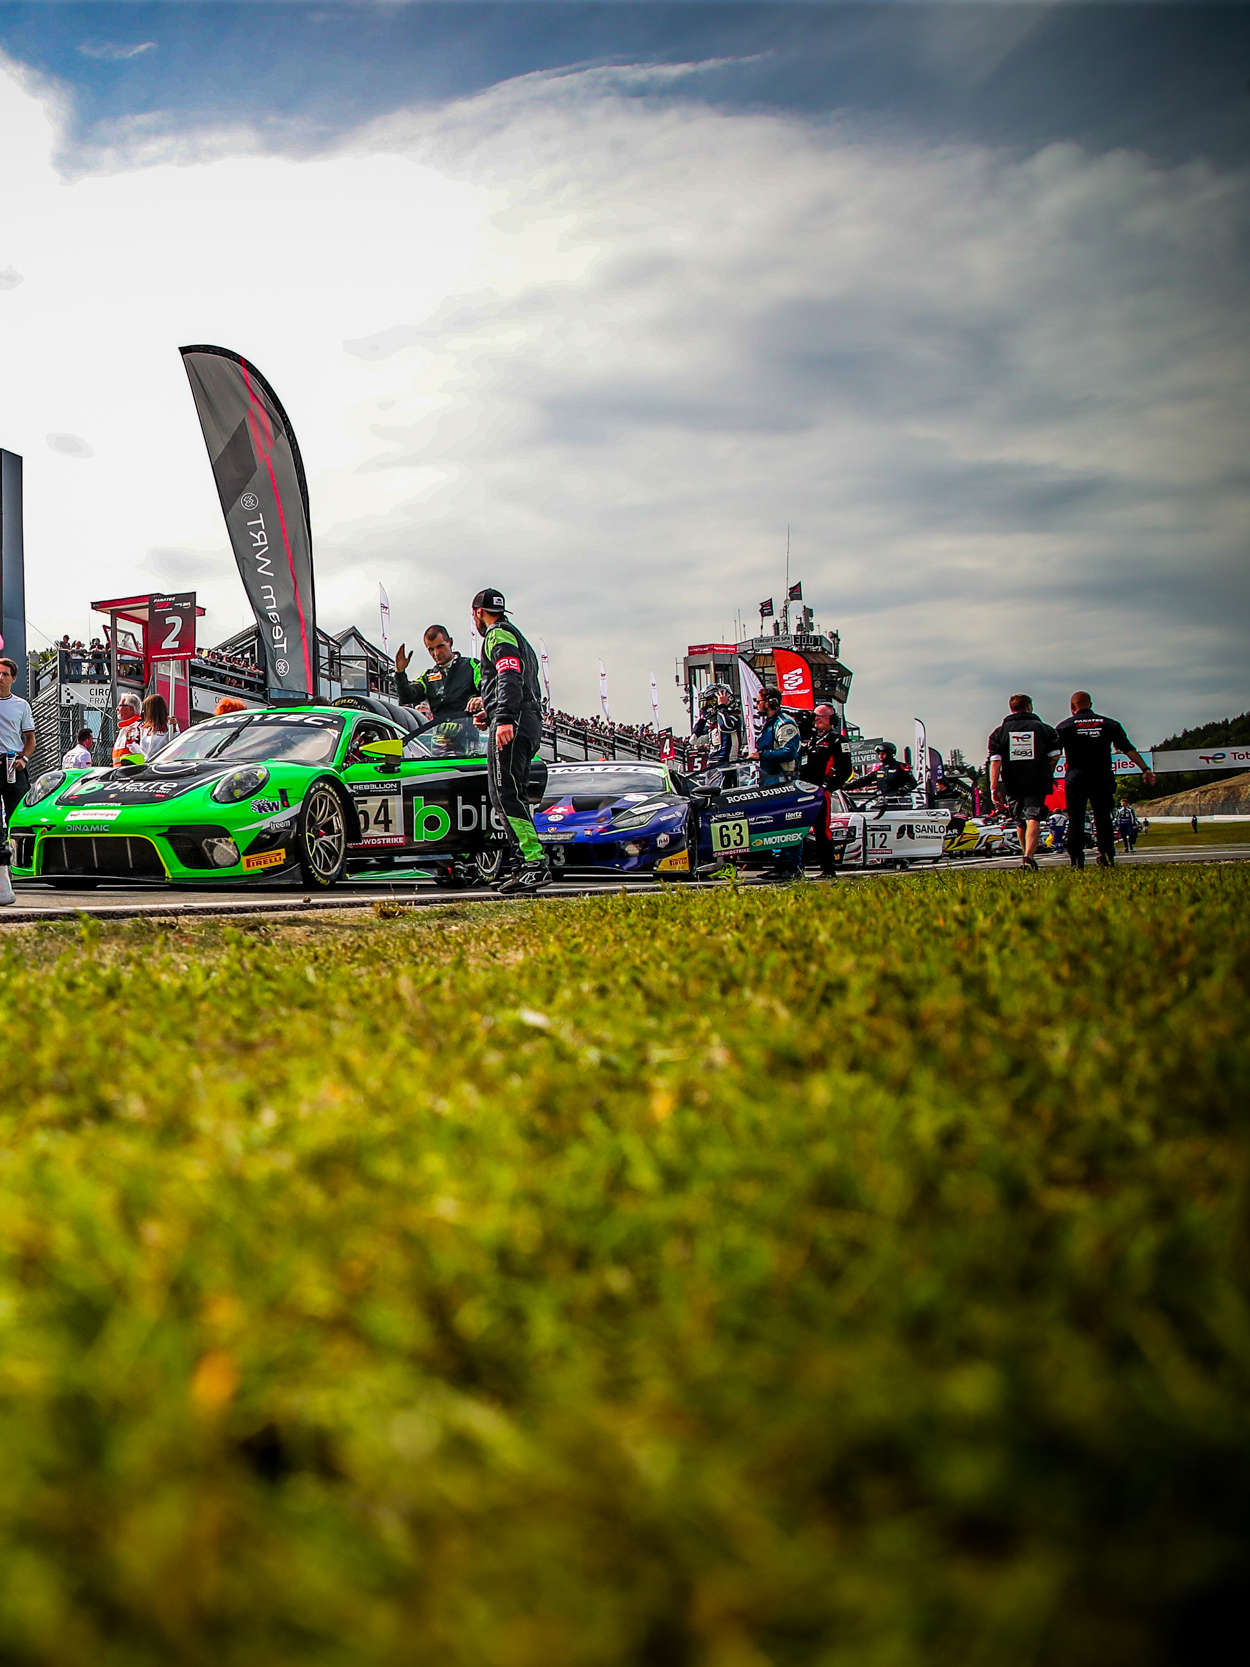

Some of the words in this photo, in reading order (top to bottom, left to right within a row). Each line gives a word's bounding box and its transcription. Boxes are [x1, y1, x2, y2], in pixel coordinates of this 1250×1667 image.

[161, 615, 183, 649] 2
[332, 698, 355, 707] ERO
[663, 738, 671, 755] 4
[692, 757, 703, 772] 5
[850, 753, 877, 764] SILVER
[103, 779, 178, 791] bierre
[726, 791, 761, 804] ROGER
[760, 785, 796, 797] DUBUIS
[257, 800, 281, 814] KW
[355, 798, 393, 834] 54
[785, 811, 803, 820] Hertz
[66, 824, 110, 832] DINAMIC
[269, 820, 291, 830] treem
[354, 836, 404, 846] OWDSTRIKE
[718, 822, 745, 849] 63
[763, 832, 803, 846] MOTOREX
[869, 832, 888, 849] 12
[246, 852, 282, 868] PIRELLI
